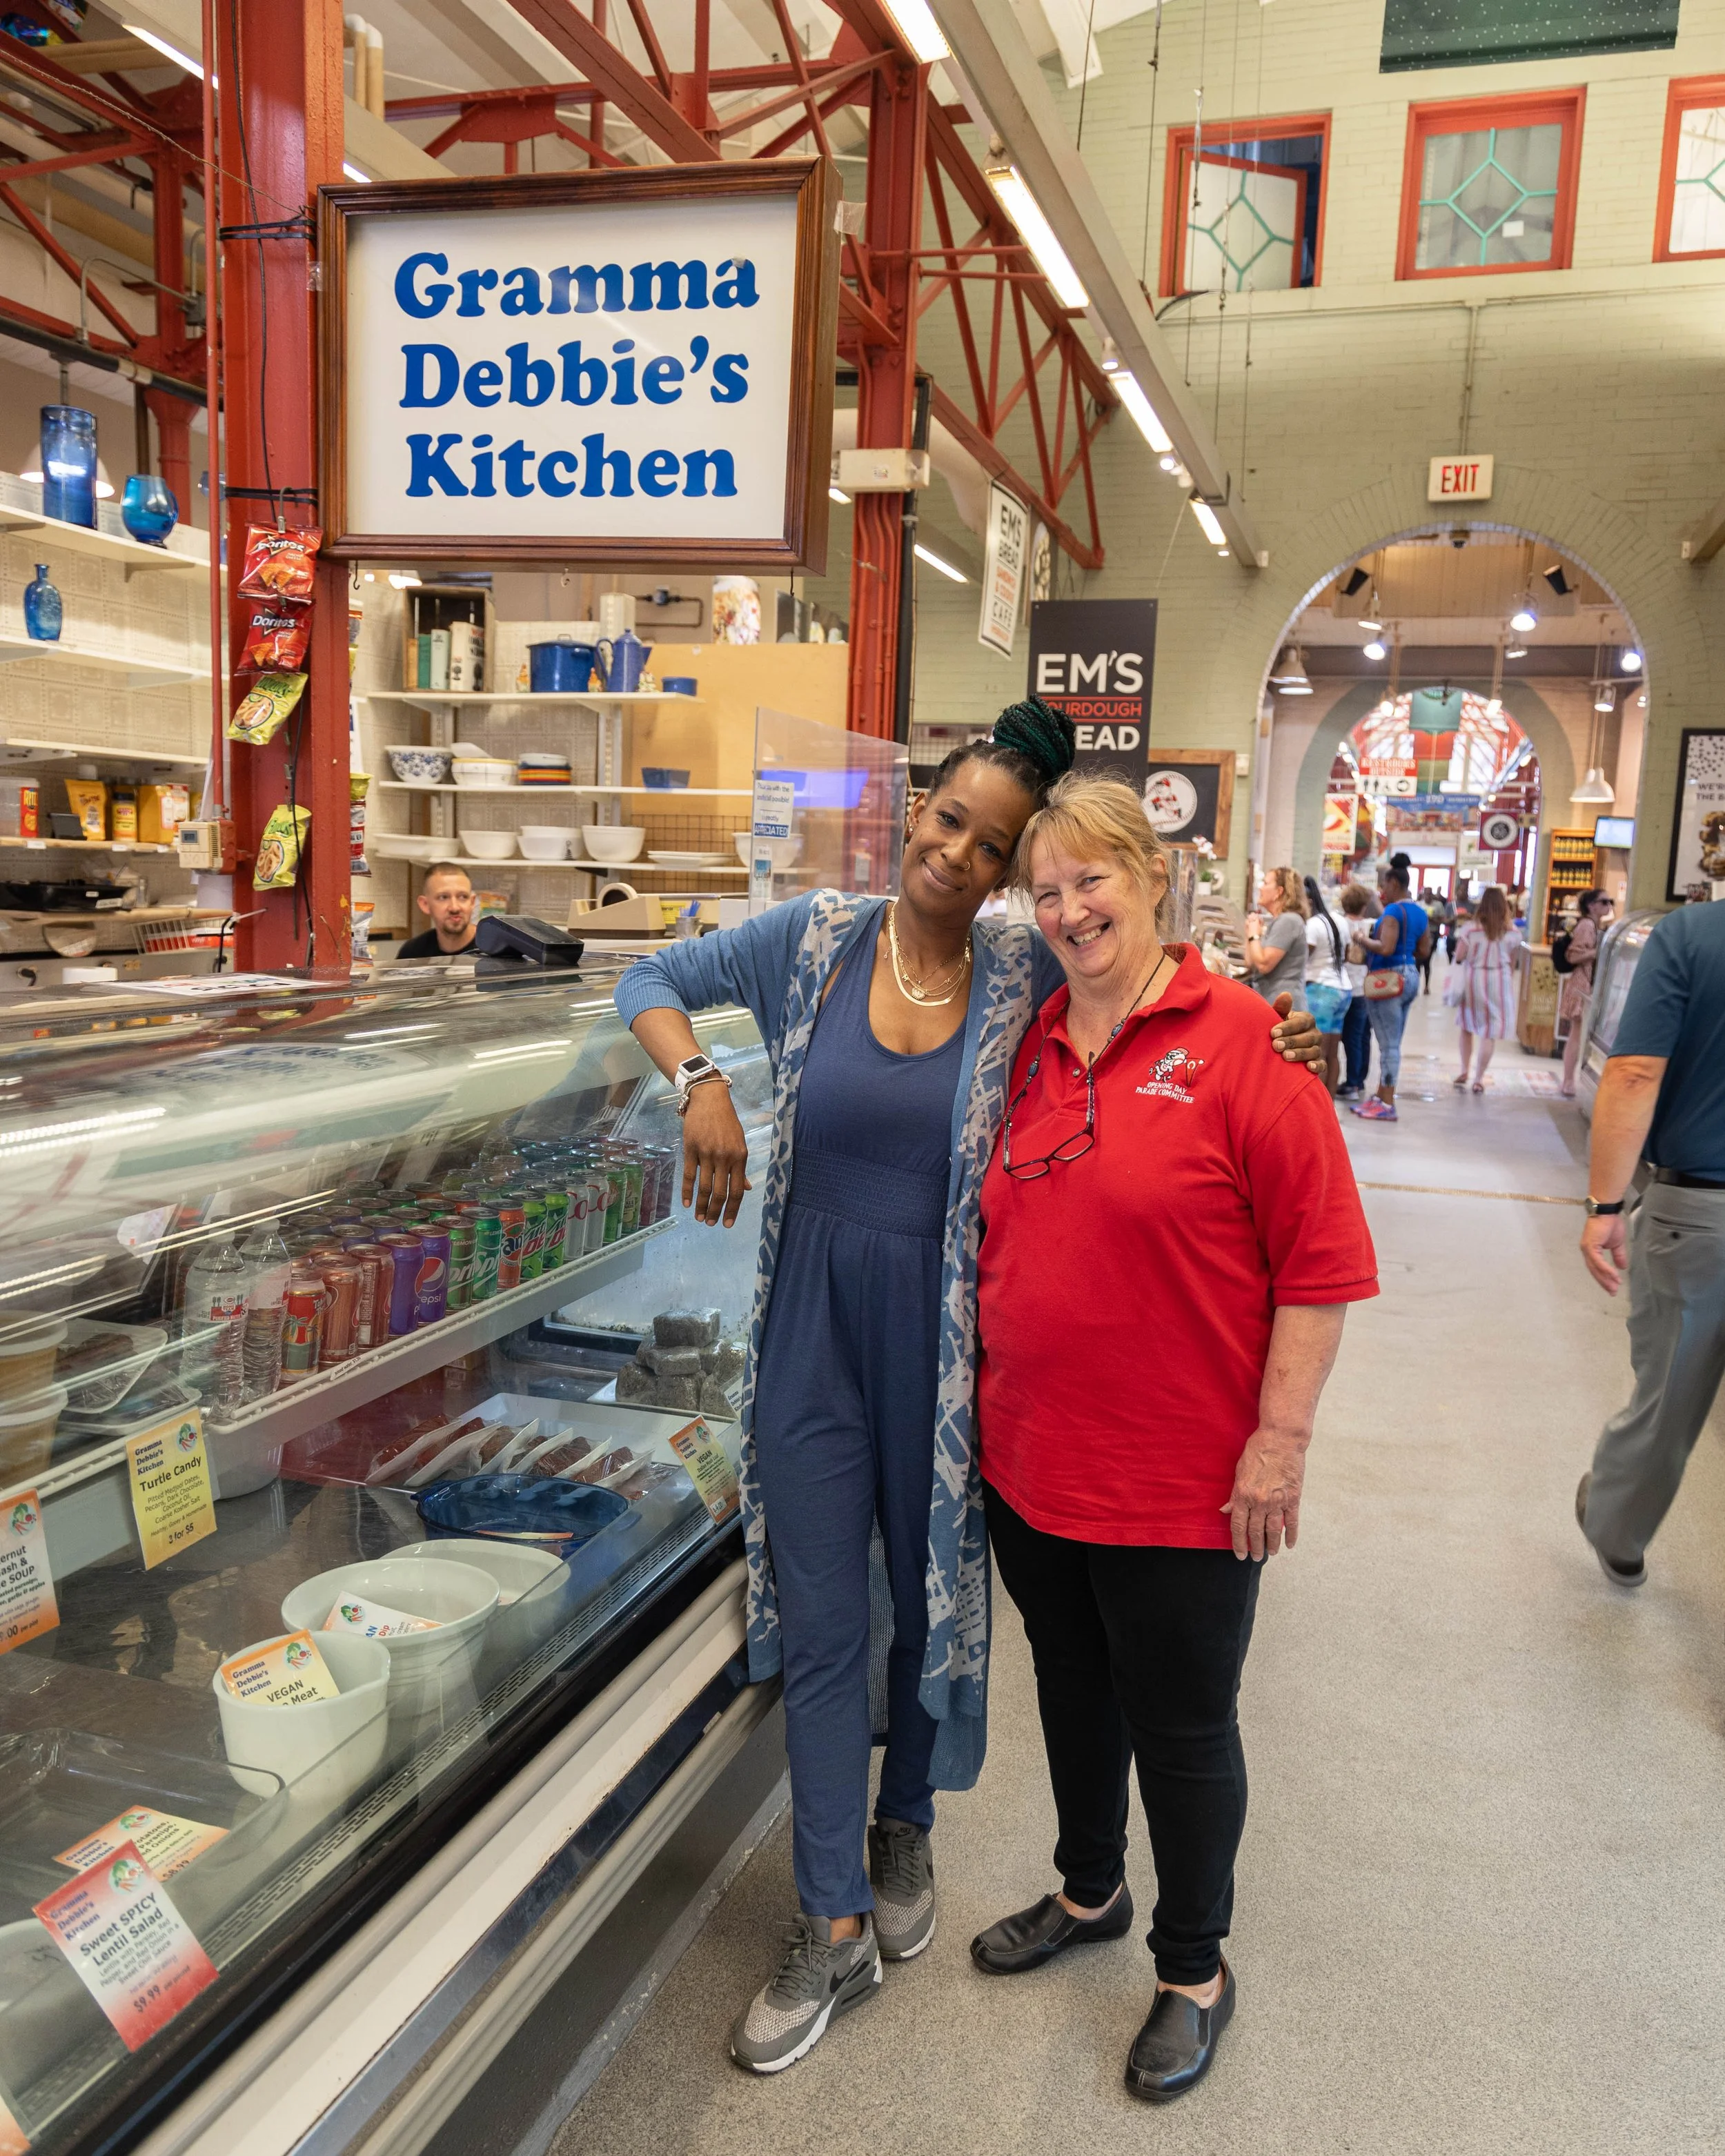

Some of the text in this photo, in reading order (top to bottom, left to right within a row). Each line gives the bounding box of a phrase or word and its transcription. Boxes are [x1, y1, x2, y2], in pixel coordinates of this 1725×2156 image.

[395, 253, 760, 318] Gramma
[400, 335, 749, 408] Debbie's
[406, 433, 738, 497] Kitchen
[1441, 464, 1479, 493] EXIT
[1000, 504, 1022, 547] EMS
[257, 540, 305, 552] Doritos
[998, 541, 1018, 570] BREAD
[253, 615, 296, 628] Doritos
[1036, 650, 1143, 693] EM'S
[1047, 702, 1142, 718] OURDOUGH
[1075, 725, 1141, 751] EAD
[1360, 758, 1416, 768] RESTROOMS
[1369, 767, 1406, 775] OUTSIDE
[1697, 793, 1714, 801] THE
[1135, 1087, 1195, 1103] PARADE COMMITTEE
[1147, 1082, 1187, 1095] OPENING DAY
[421, 1294, 442, 1305] epsi
[135, 1440, 163, 1456] Gramma
[137, 1449, 164, 1466] Debbie's
[696, 1450, 713, 1465] VEGAN
[137, 1460, 164, 1476] Kitchen
[139, 1456, 201, 1492] Turtle Candy
[148, 1492, 164, 1503] Pitted
[165, 1482, 184, 1496] Medjool
[167, 1493, 179, 1503] Dark
[155, 1496, 201, 1524] Coarse Kosher Salt
[162, 1497, 183, 1512] Coconut
[168, 1522, 194, 1544] 3 for $5
[0, 1545, 27, 1565] ernut
[0, 1557, 28, 1576] ash &
[9, 1565, 35, 1584] SOUP
[0, 1588, 14, 1598] asted
[29, 1581, 46, 1592] apples
[379, 1624, 389, 1637] Dip
[233, 1661, 266, 1679] Gramma
[237, 1669, 268, 1688] Debbie's
[241, 1679, 271, 1697] Kitchen
[266, 1679, 304, 1703] VEGAN
[291, 1687, 318, 1705] Meat
[135, 1821, 170, 1844] otatoes,
[139, 1823, 177, 1849] Parsnips,
[151, 1828, 179, 1848] Onions
[50, 1890, 89, 1919] Gramma
[58, 1901, 95, 1930] Debbie's
[80, 1892, 157, 1957] Sweet SPICY
[65, 1914, 101, 1941] Kitchen
[92, 1907, 164, 1967] Lentil Salad
[99, 1918, 171, 1977] Lentils with Parsley, Red
[124, 1957, 137, 1969] and
[136, 1946, 149, 1958] Red
[148, 1932, 168, 1949] Onion
[167, 1926, 174, 1935] in
[118, 1966, 138, 1985] Sweet
[152, 1940, 171, 1958] Sauce
[134, 1984, 161, 2012] $9.99
